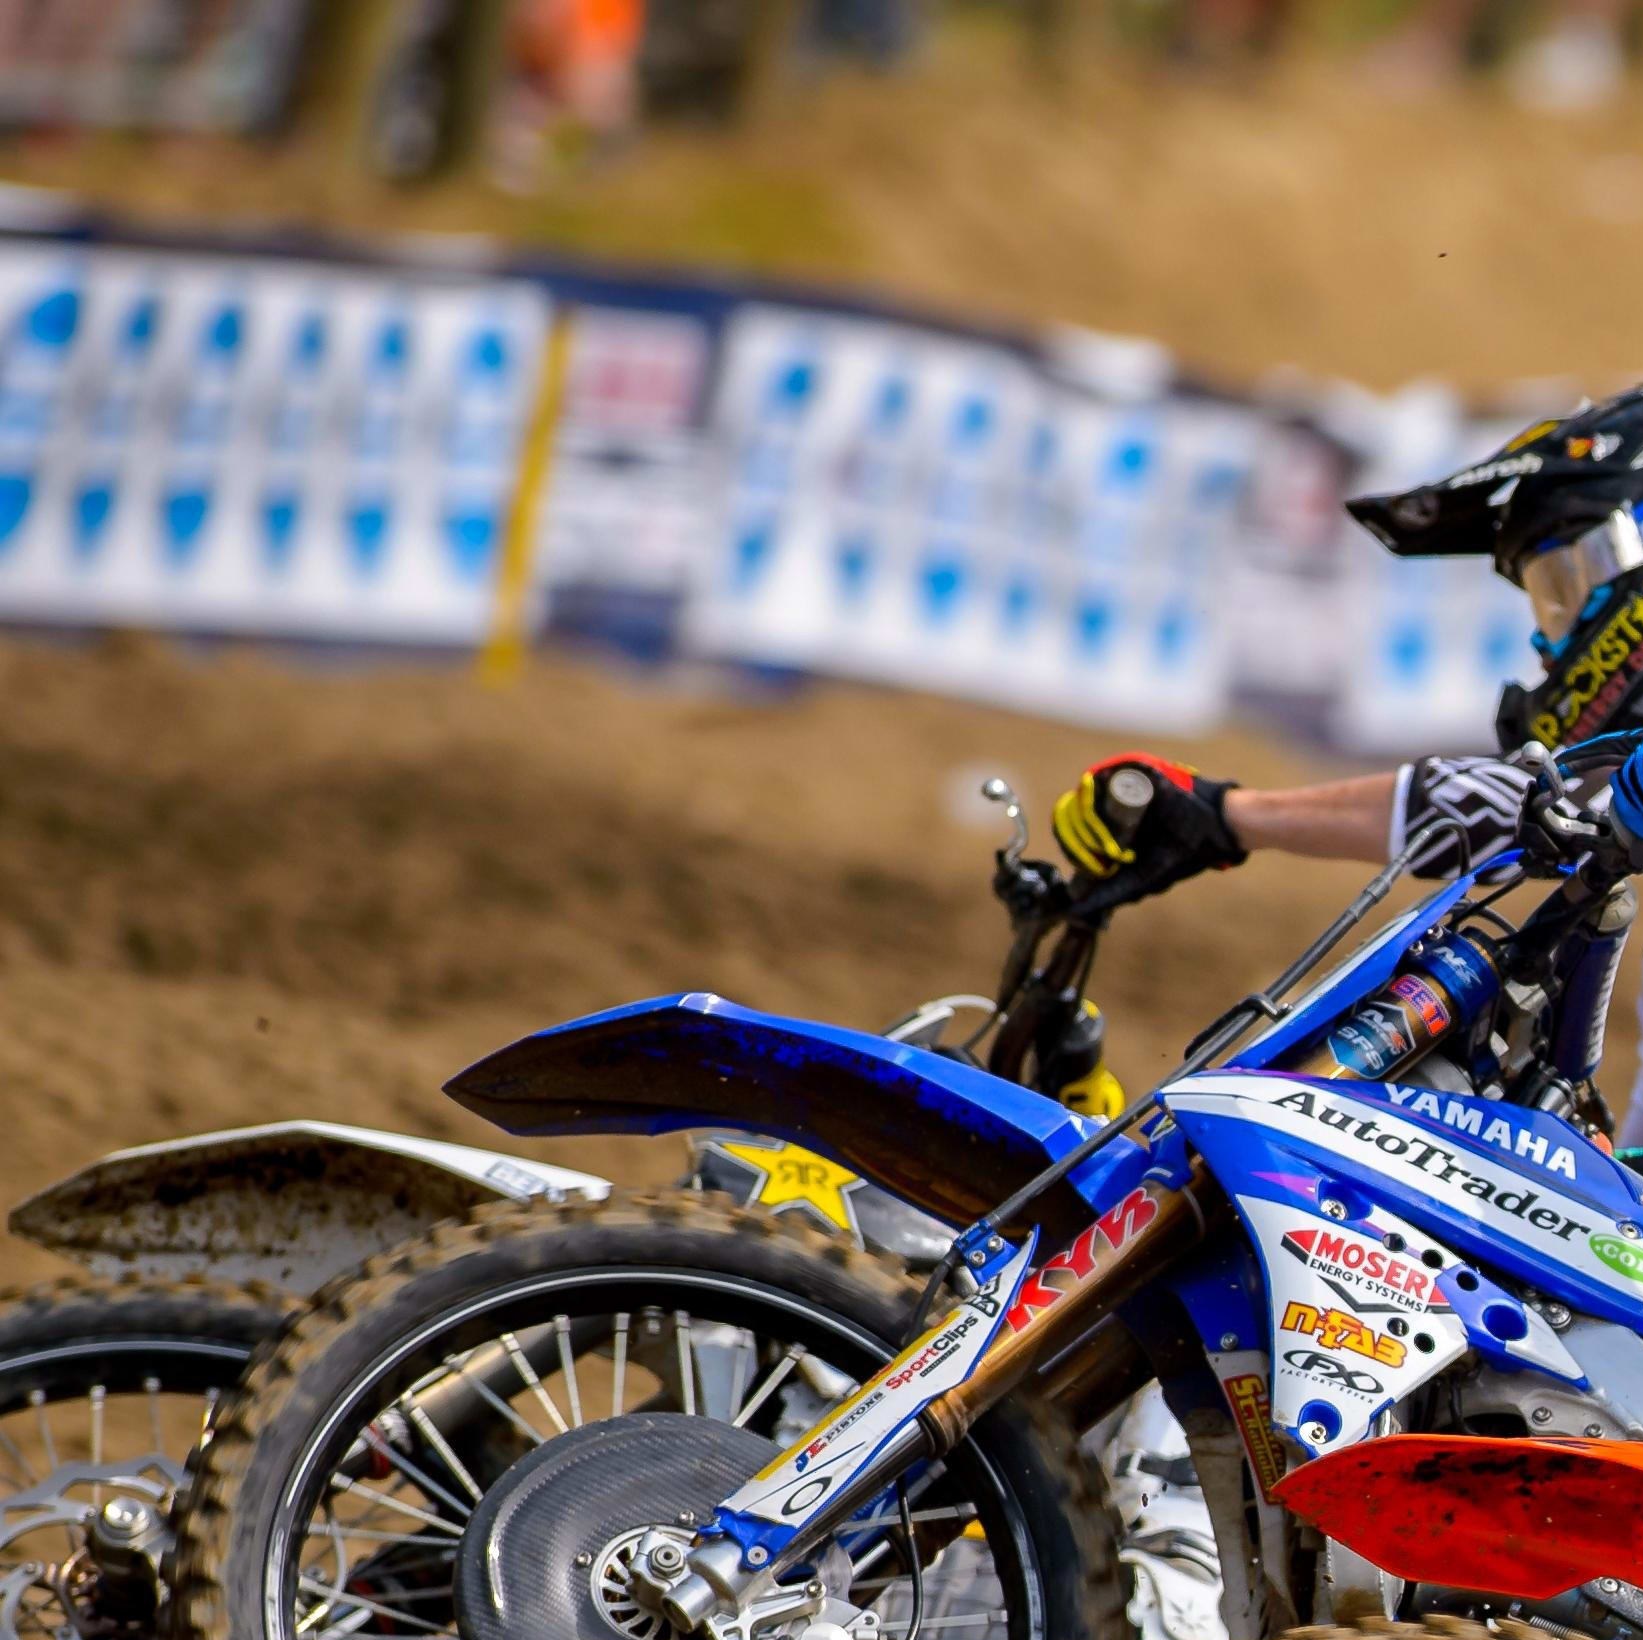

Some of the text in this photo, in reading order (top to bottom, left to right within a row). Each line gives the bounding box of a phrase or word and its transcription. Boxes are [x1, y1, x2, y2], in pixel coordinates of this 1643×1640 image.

[1273, 1089, 1592, 1243] AutoTrader
[1384, 1081, 1579, 1182] YAMAHA
[1004, 1186, 1161, 1335] KYB
[1309, 1258, 1423, 1313] ENERGY SYSTEMS
[1315, 1231, 1429, 1301] MOSER
[1279, 1368, 1334, 1388] FACTORY
[824, 1390, 885, 1443] PISTONS
